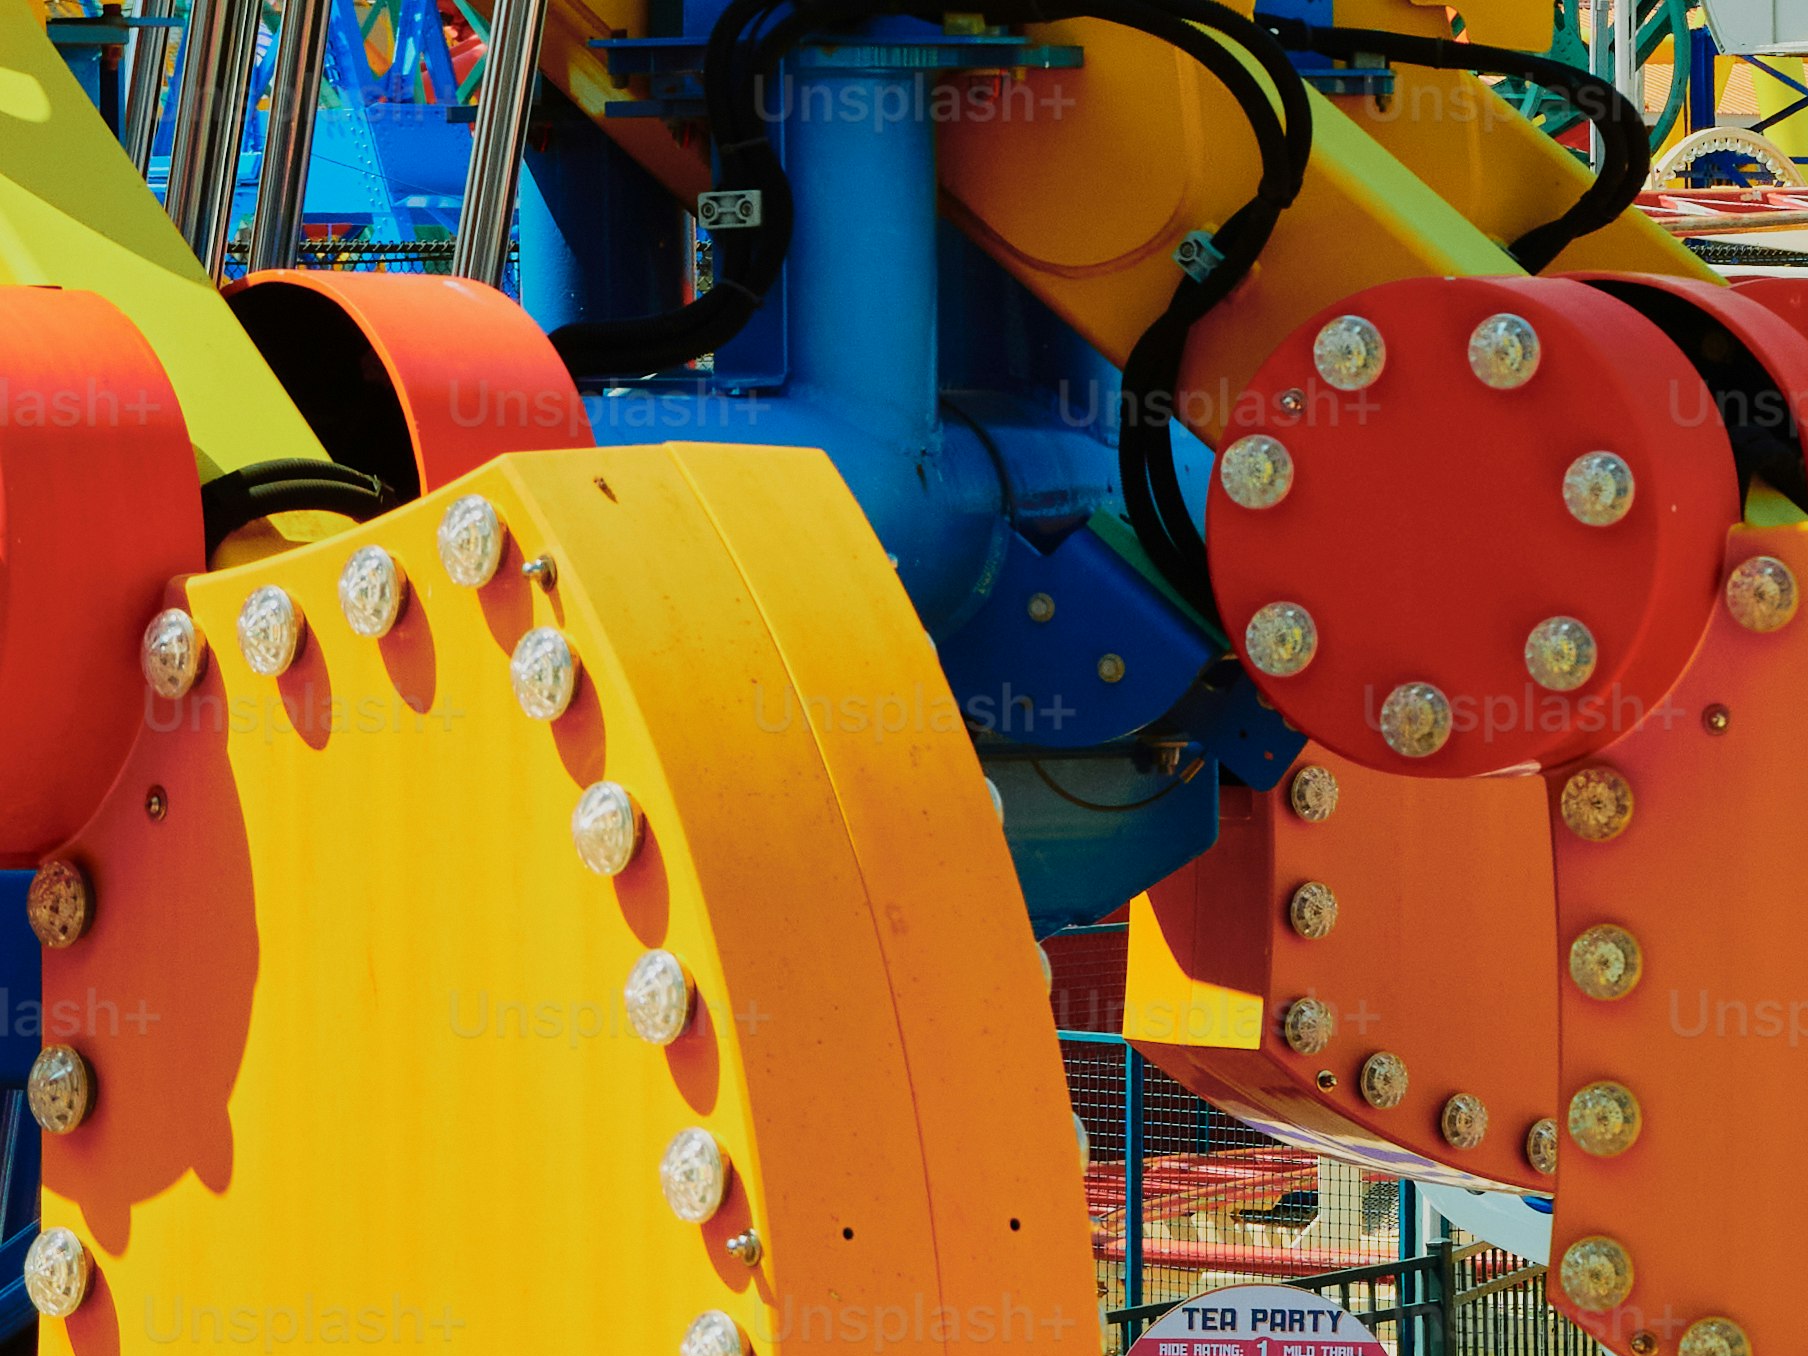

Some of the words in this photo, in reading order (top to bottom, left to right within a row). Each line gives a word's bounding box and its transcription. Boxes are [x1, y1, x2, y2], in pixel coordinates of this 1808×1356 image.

[1182, 1308, 1237, 1331] TEA
[1251, 1309, 1344, 1333] PARTY
[1159, 1343, 1188, 1356] RIDE
[1193, 1344, 1244, 1356] RATING:
